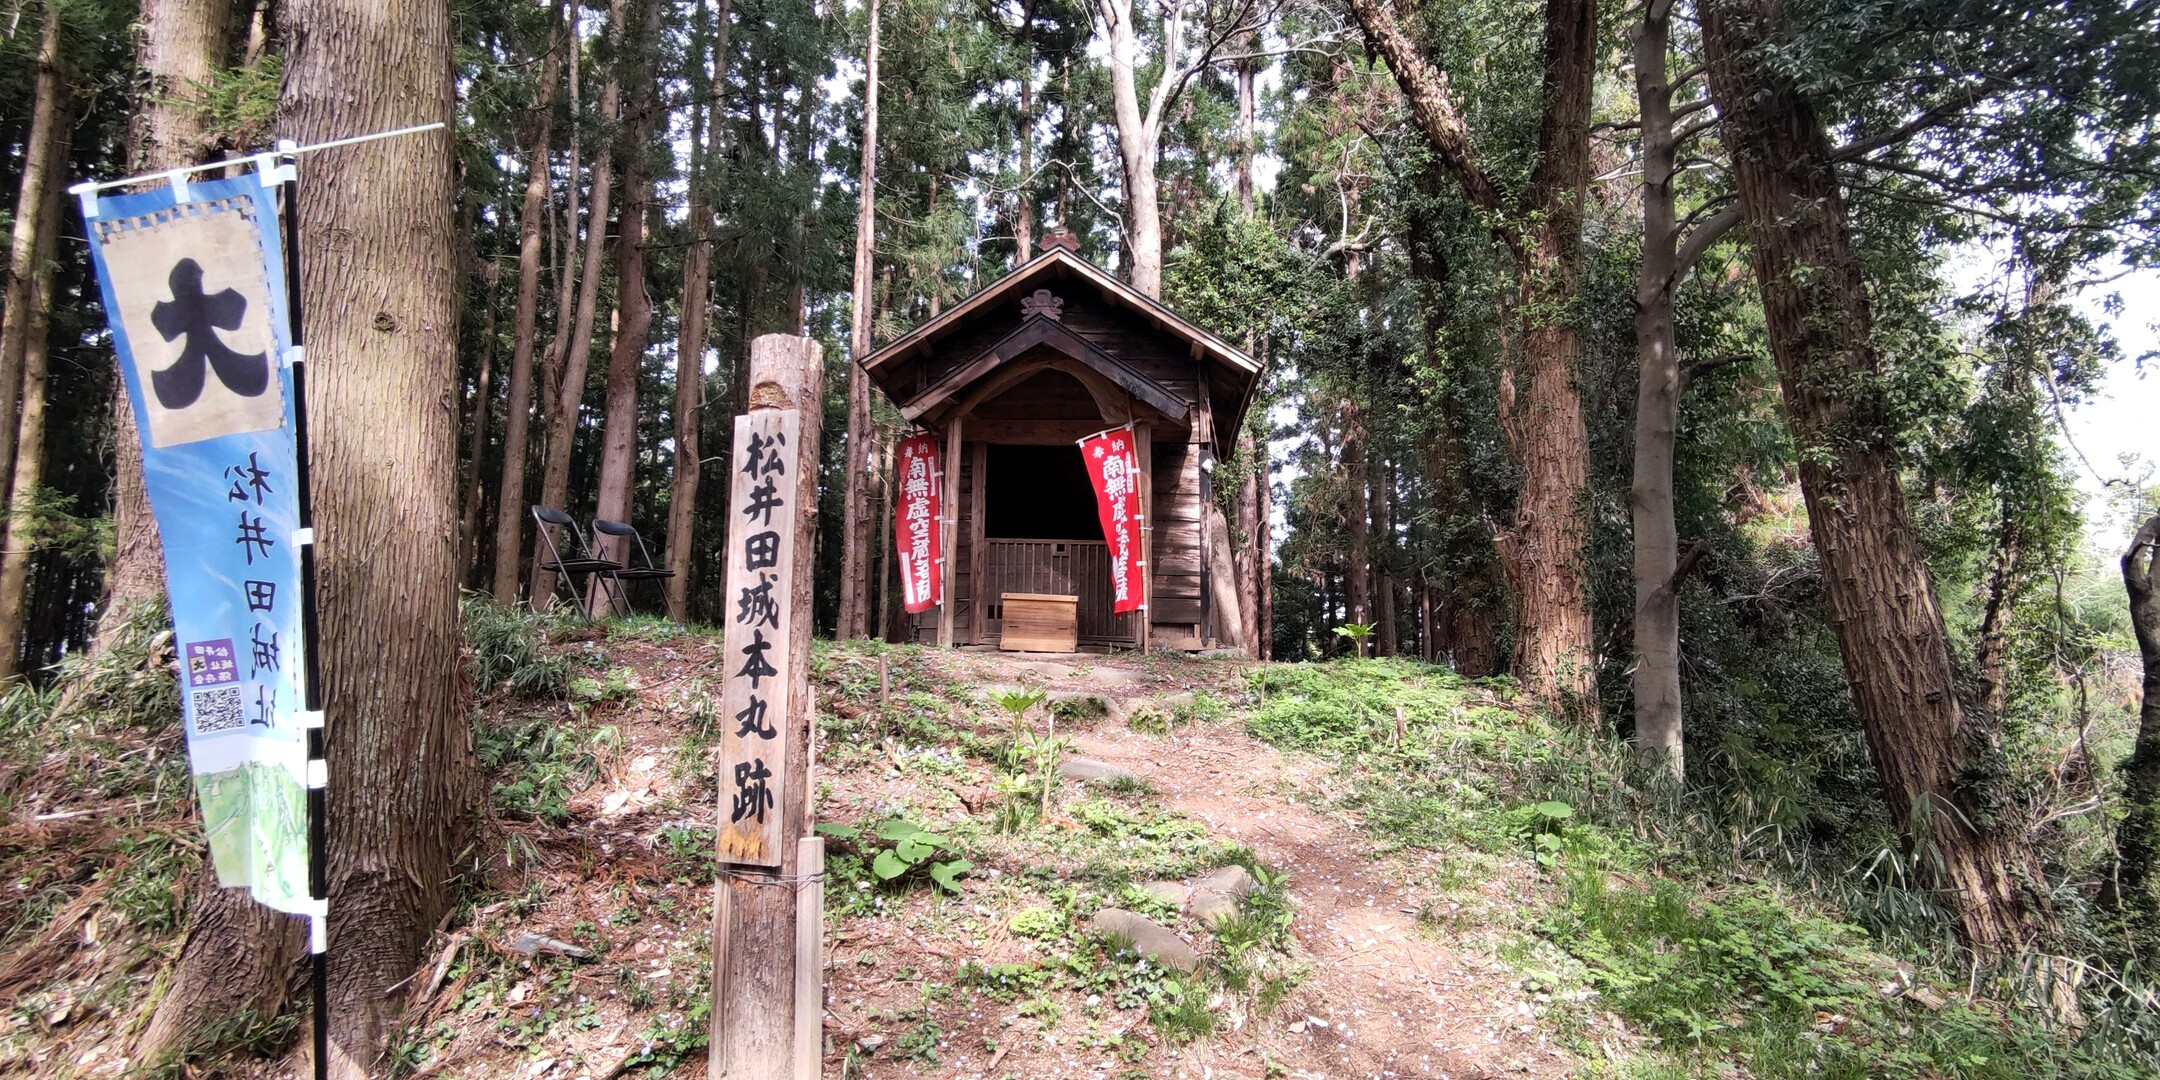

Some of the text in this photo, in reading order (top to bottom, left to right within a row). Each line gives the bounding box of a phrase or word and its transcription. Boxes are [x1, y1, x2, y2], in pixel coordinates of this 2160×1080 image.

[1092, 439, 1125, 459] 奉納
[730, 432, 786, 825] 松井田城本丸跡
